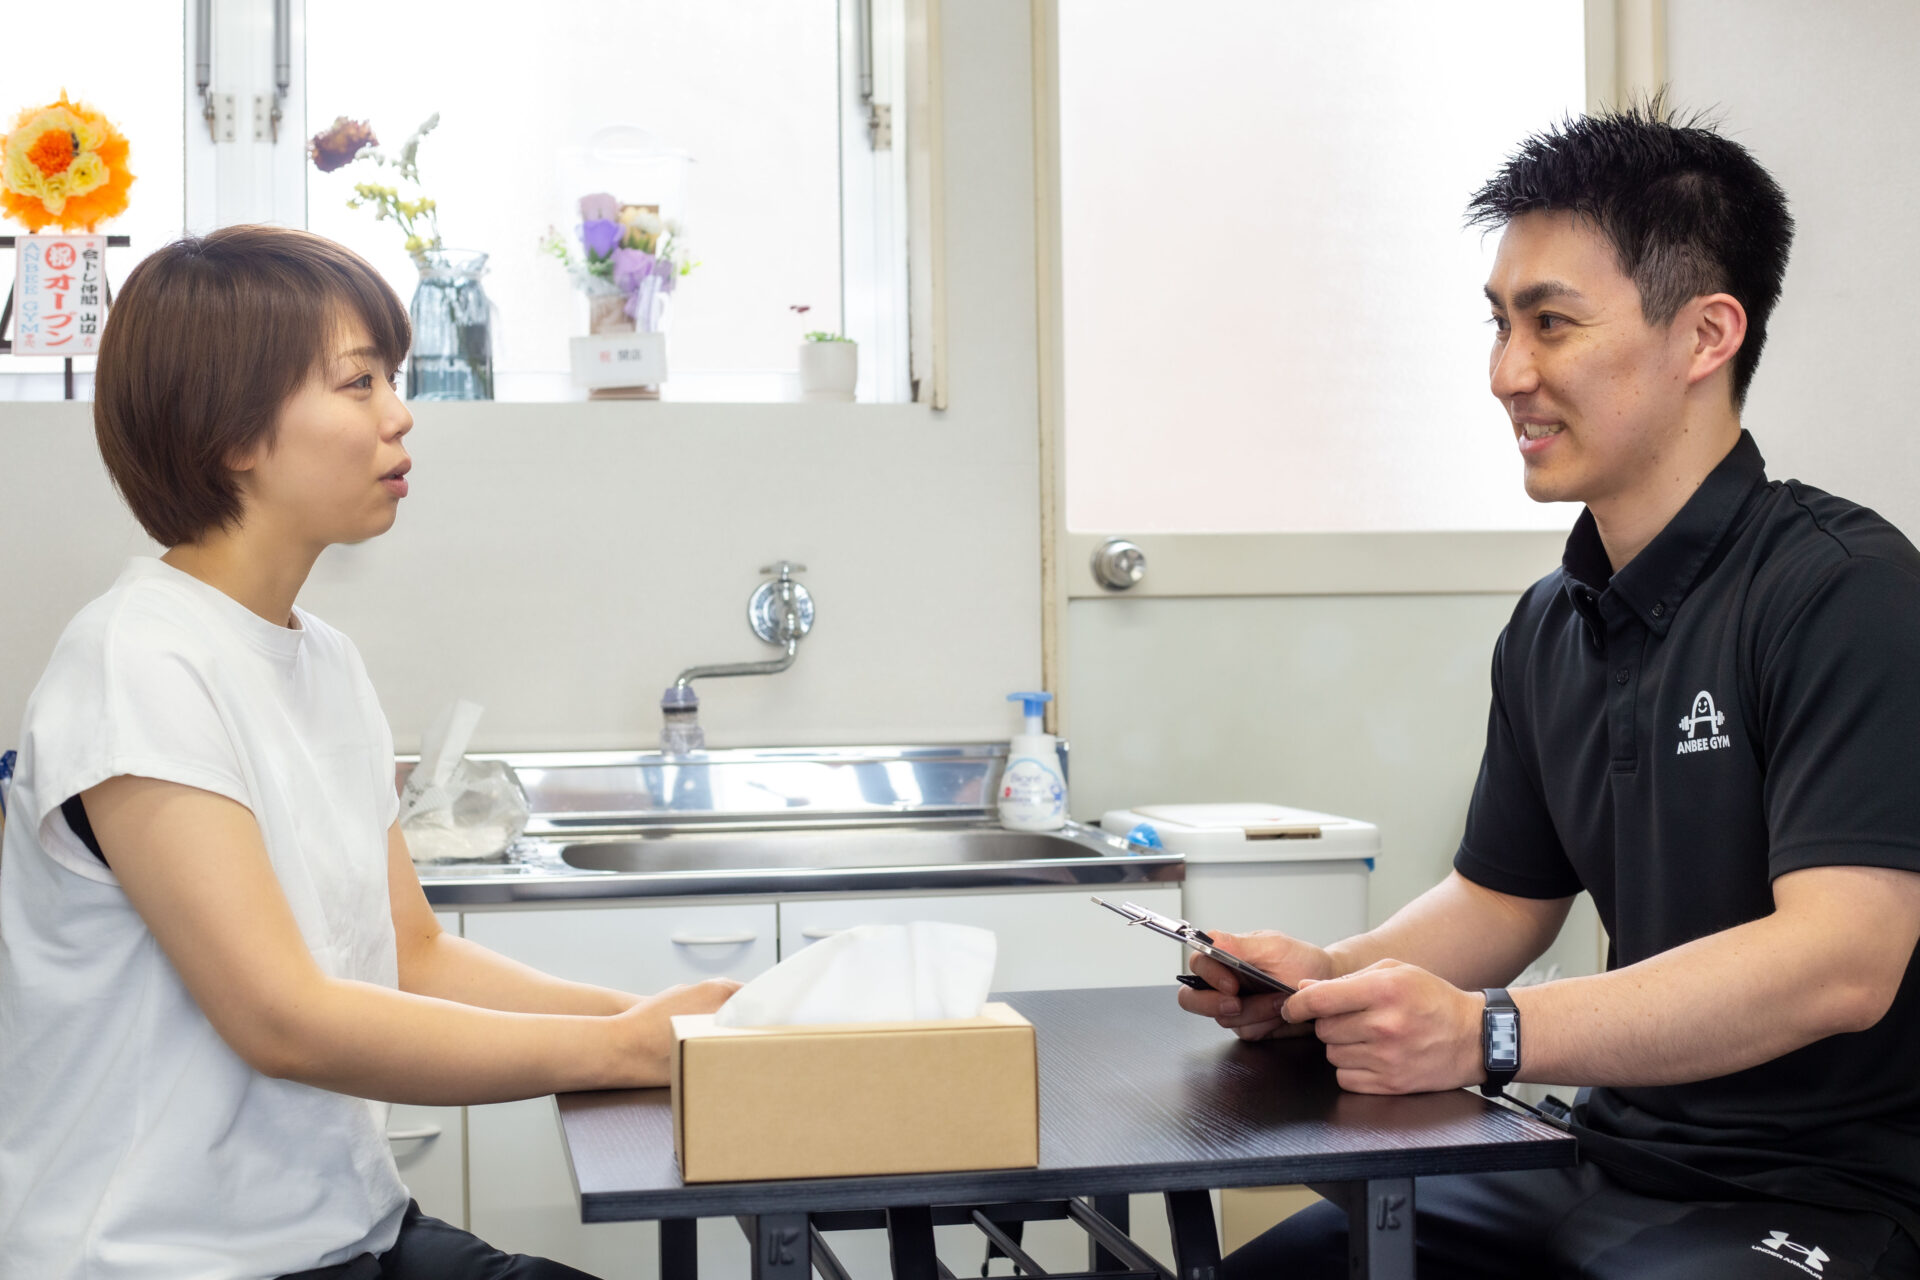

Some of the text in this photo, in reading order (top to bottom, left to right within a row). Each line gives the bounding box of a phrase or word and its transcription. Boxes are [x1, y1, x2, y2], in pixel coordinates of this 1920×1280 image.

[24, 242, 40, 296] ANBEE
[21, 301, 39, 334] GYM
[41, 274, 78, 347] オープン
[1677, 734, 1731, 755] ANBEE GYM
